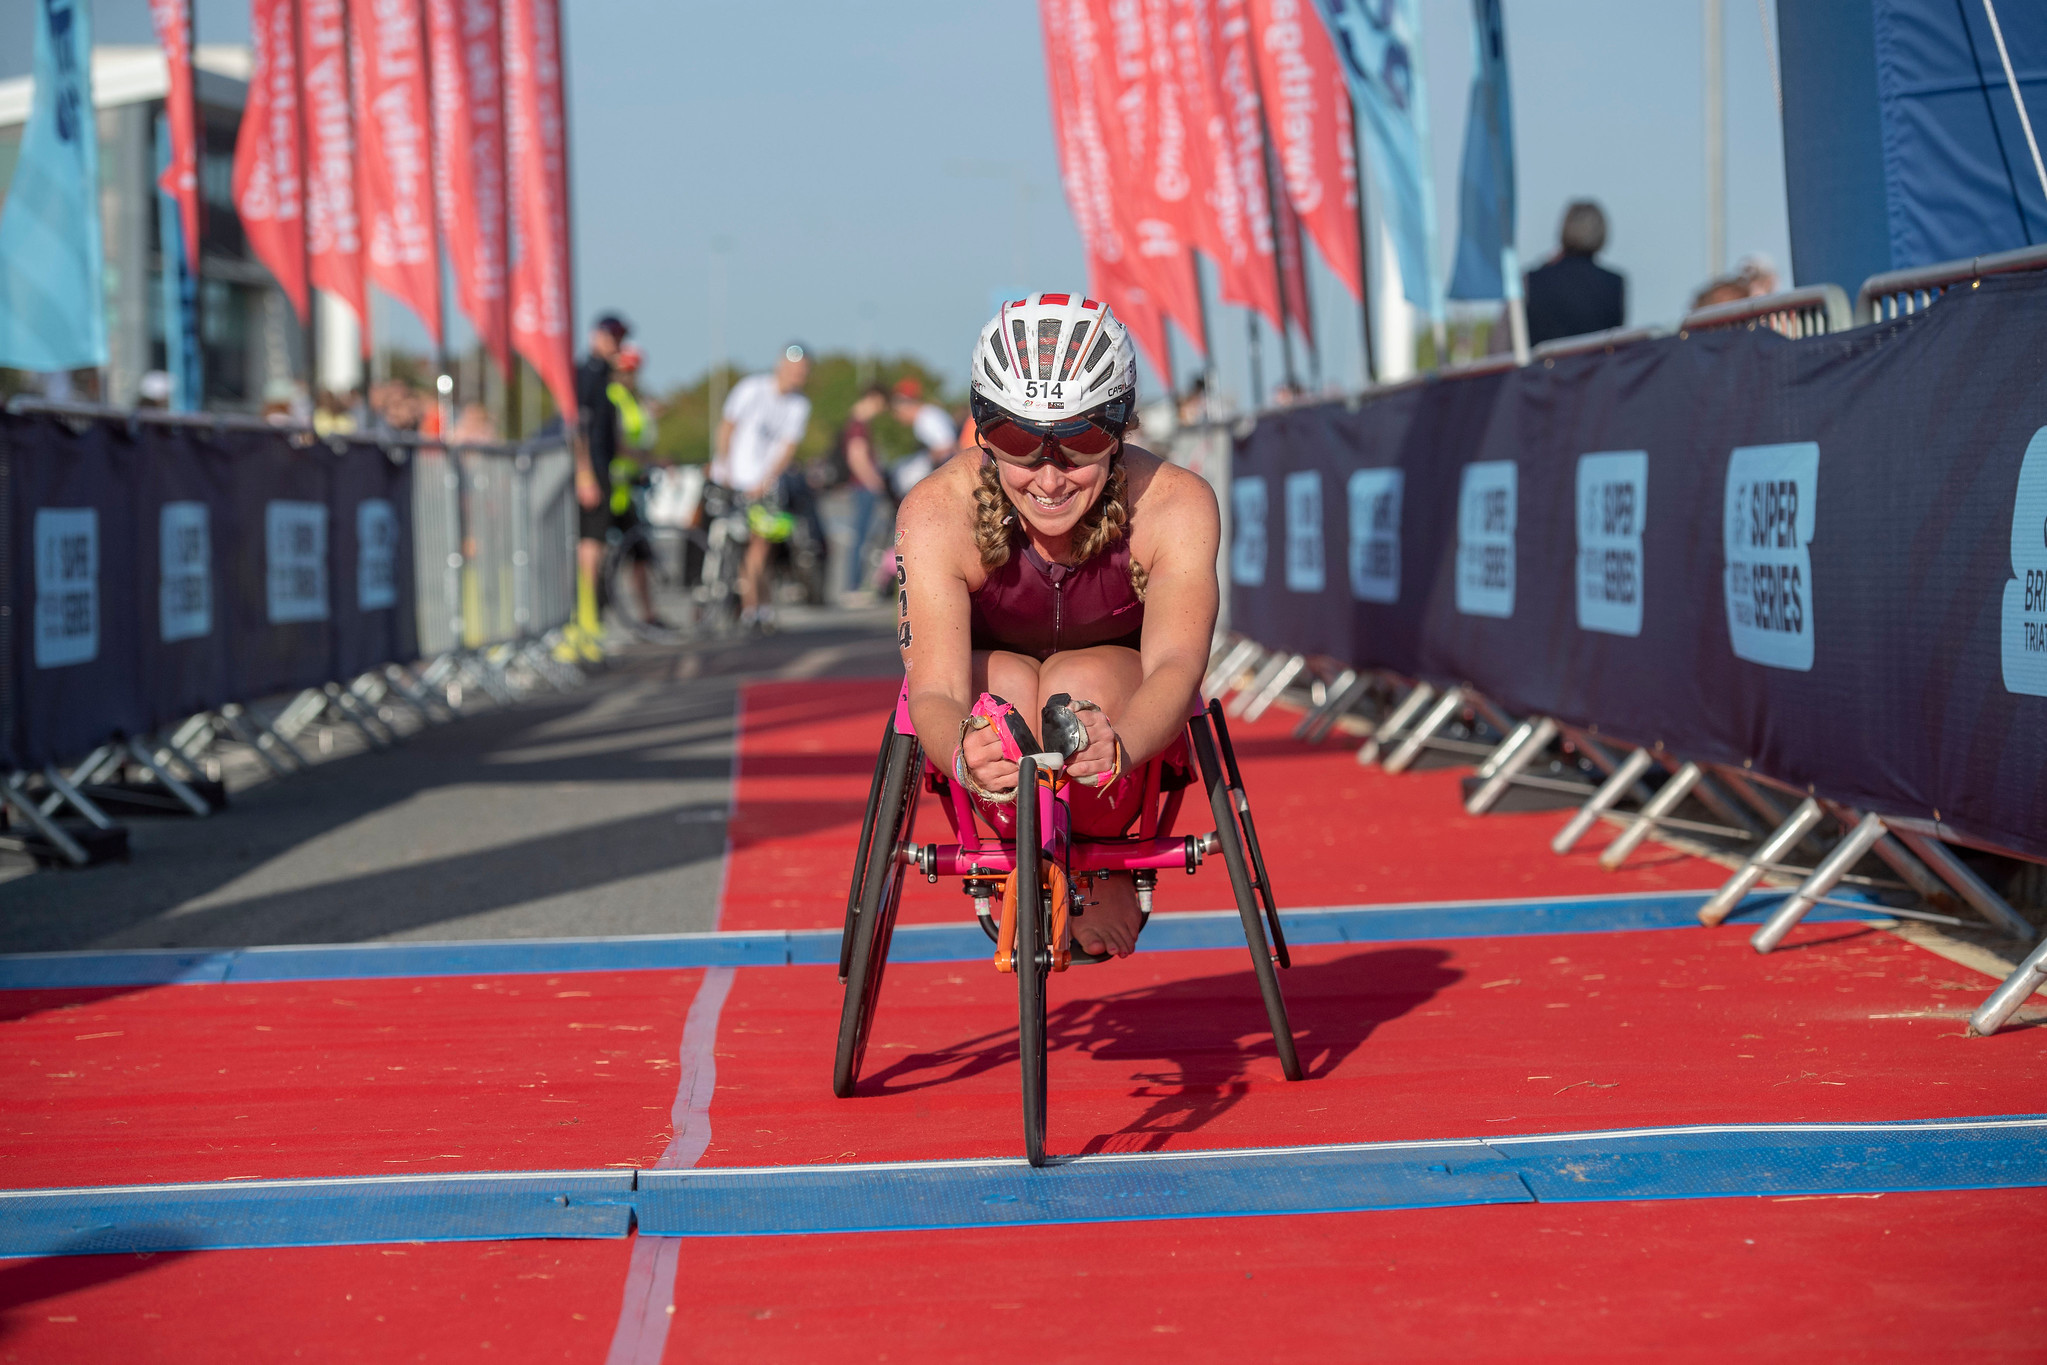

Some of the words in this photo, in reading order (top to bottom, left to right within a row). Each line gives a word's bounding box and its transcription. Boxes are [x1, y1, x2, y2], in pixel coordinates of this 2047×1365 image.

[1025, 380, 1063, 399] 514
[1752, 480, 1799, 548] SUPER
[1752, 563, 1804, 635] SERIES
